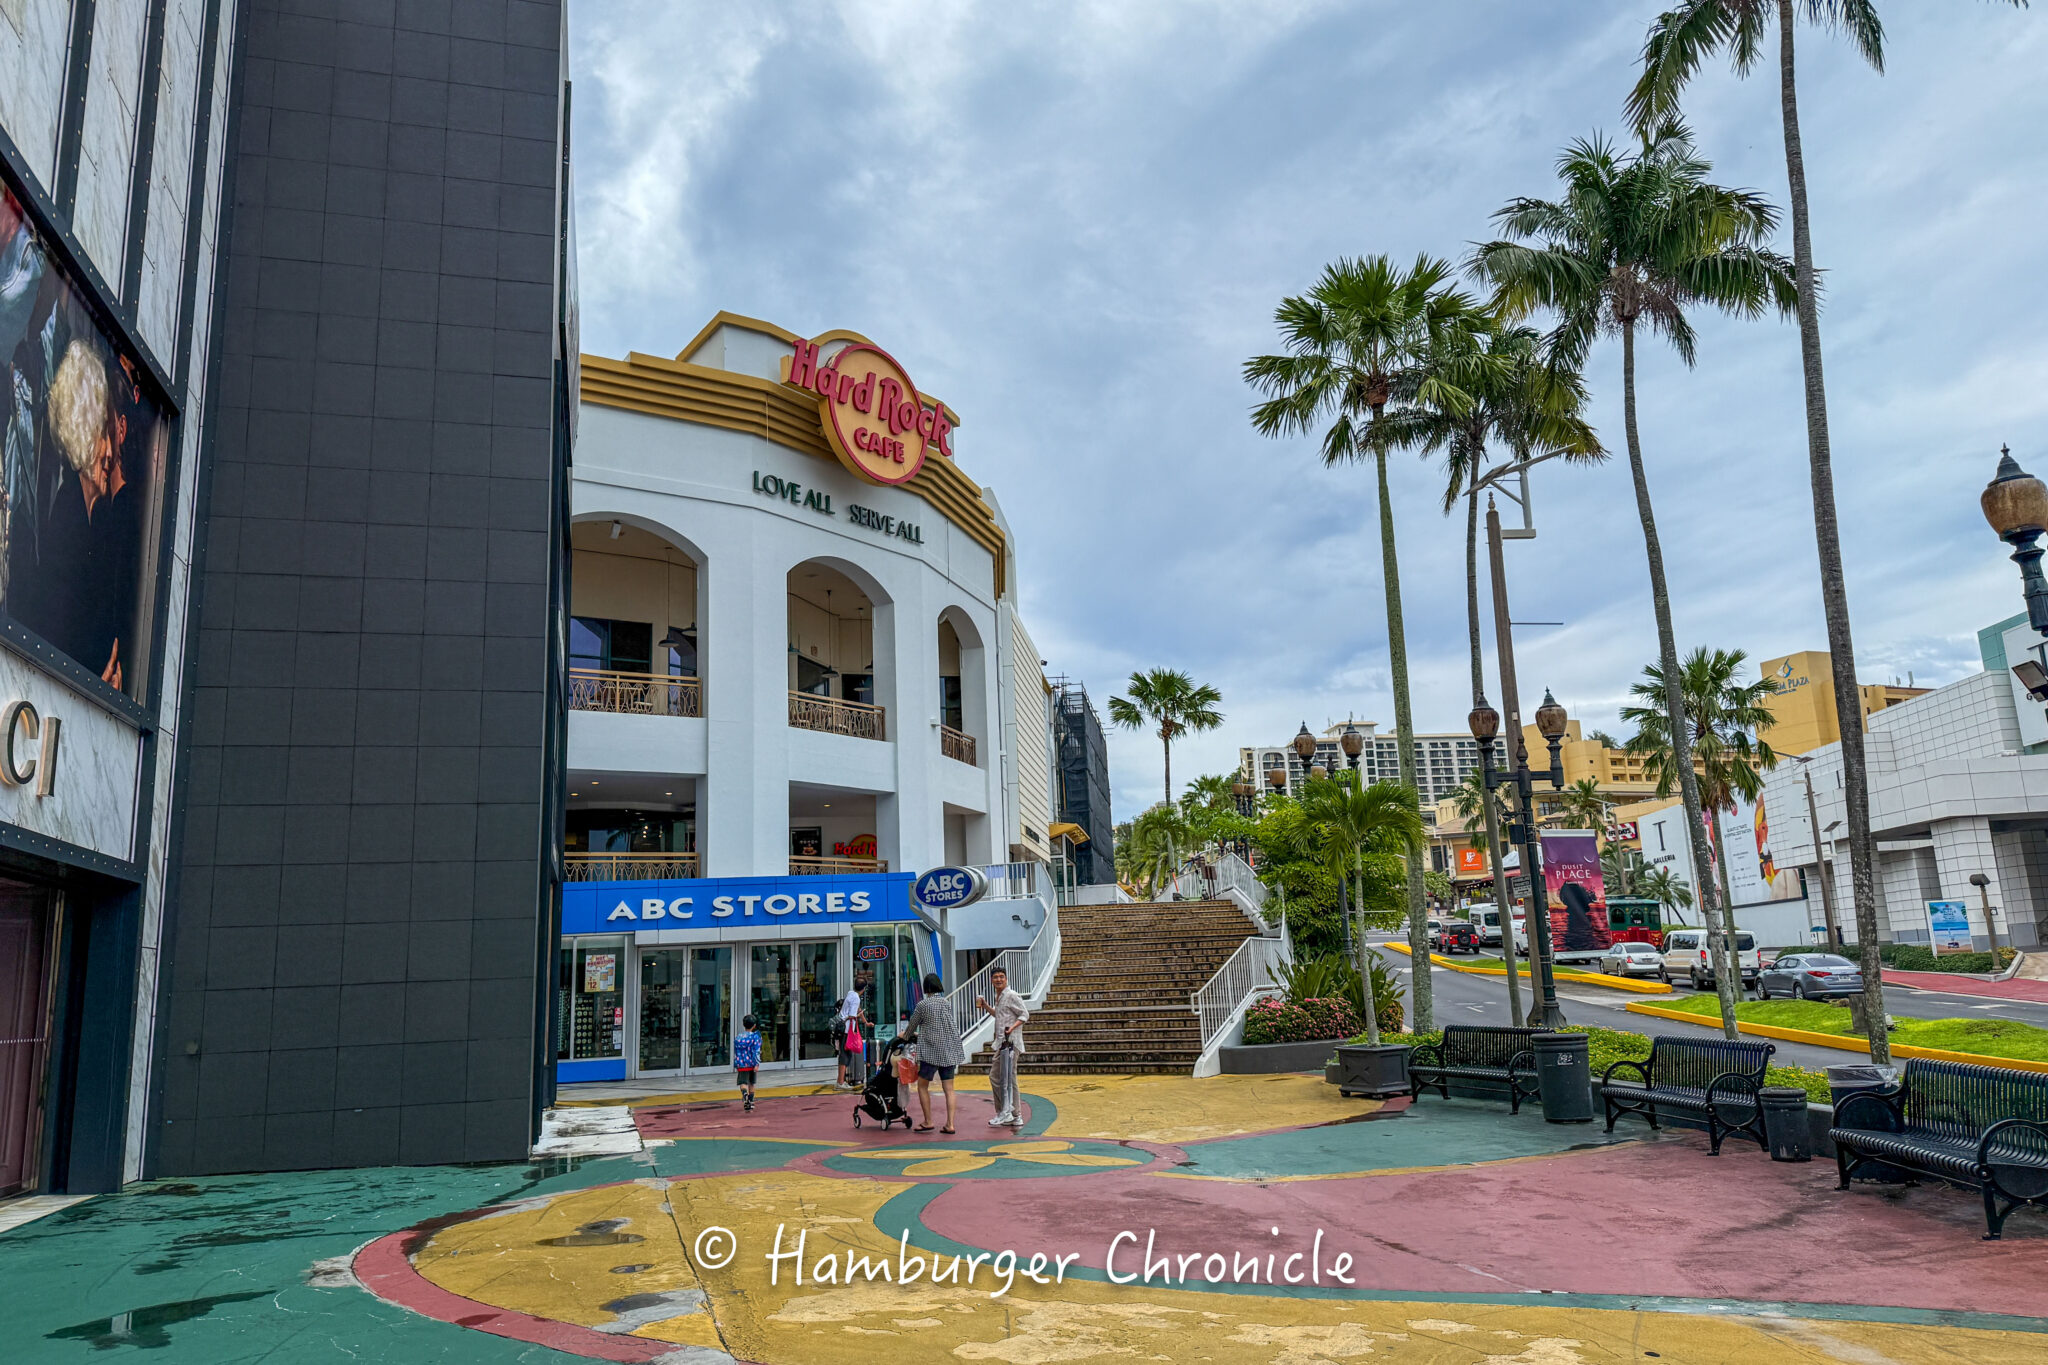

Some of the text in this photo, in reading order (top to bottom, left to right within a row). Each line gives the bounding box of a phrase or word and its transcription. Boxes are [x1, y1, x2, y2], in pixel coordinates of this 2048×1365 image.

[789, 338, 952, 456] Hard Rock
[853, 426, 905, 464] CAFE
[753, 470, 925, 545] LOVE ALL SERVE ALL
[1652, 820, 1667, 851] T
[833, 842, 866, 856] Hard
[924, 873, 964, 894] ABC
[1556, 869, 1593, 880] PLACE
[606, 891, 871, 921] ABC STORES
[926, 890, 963, 902] STORES
[861, 947, 887, 959] OPEN
